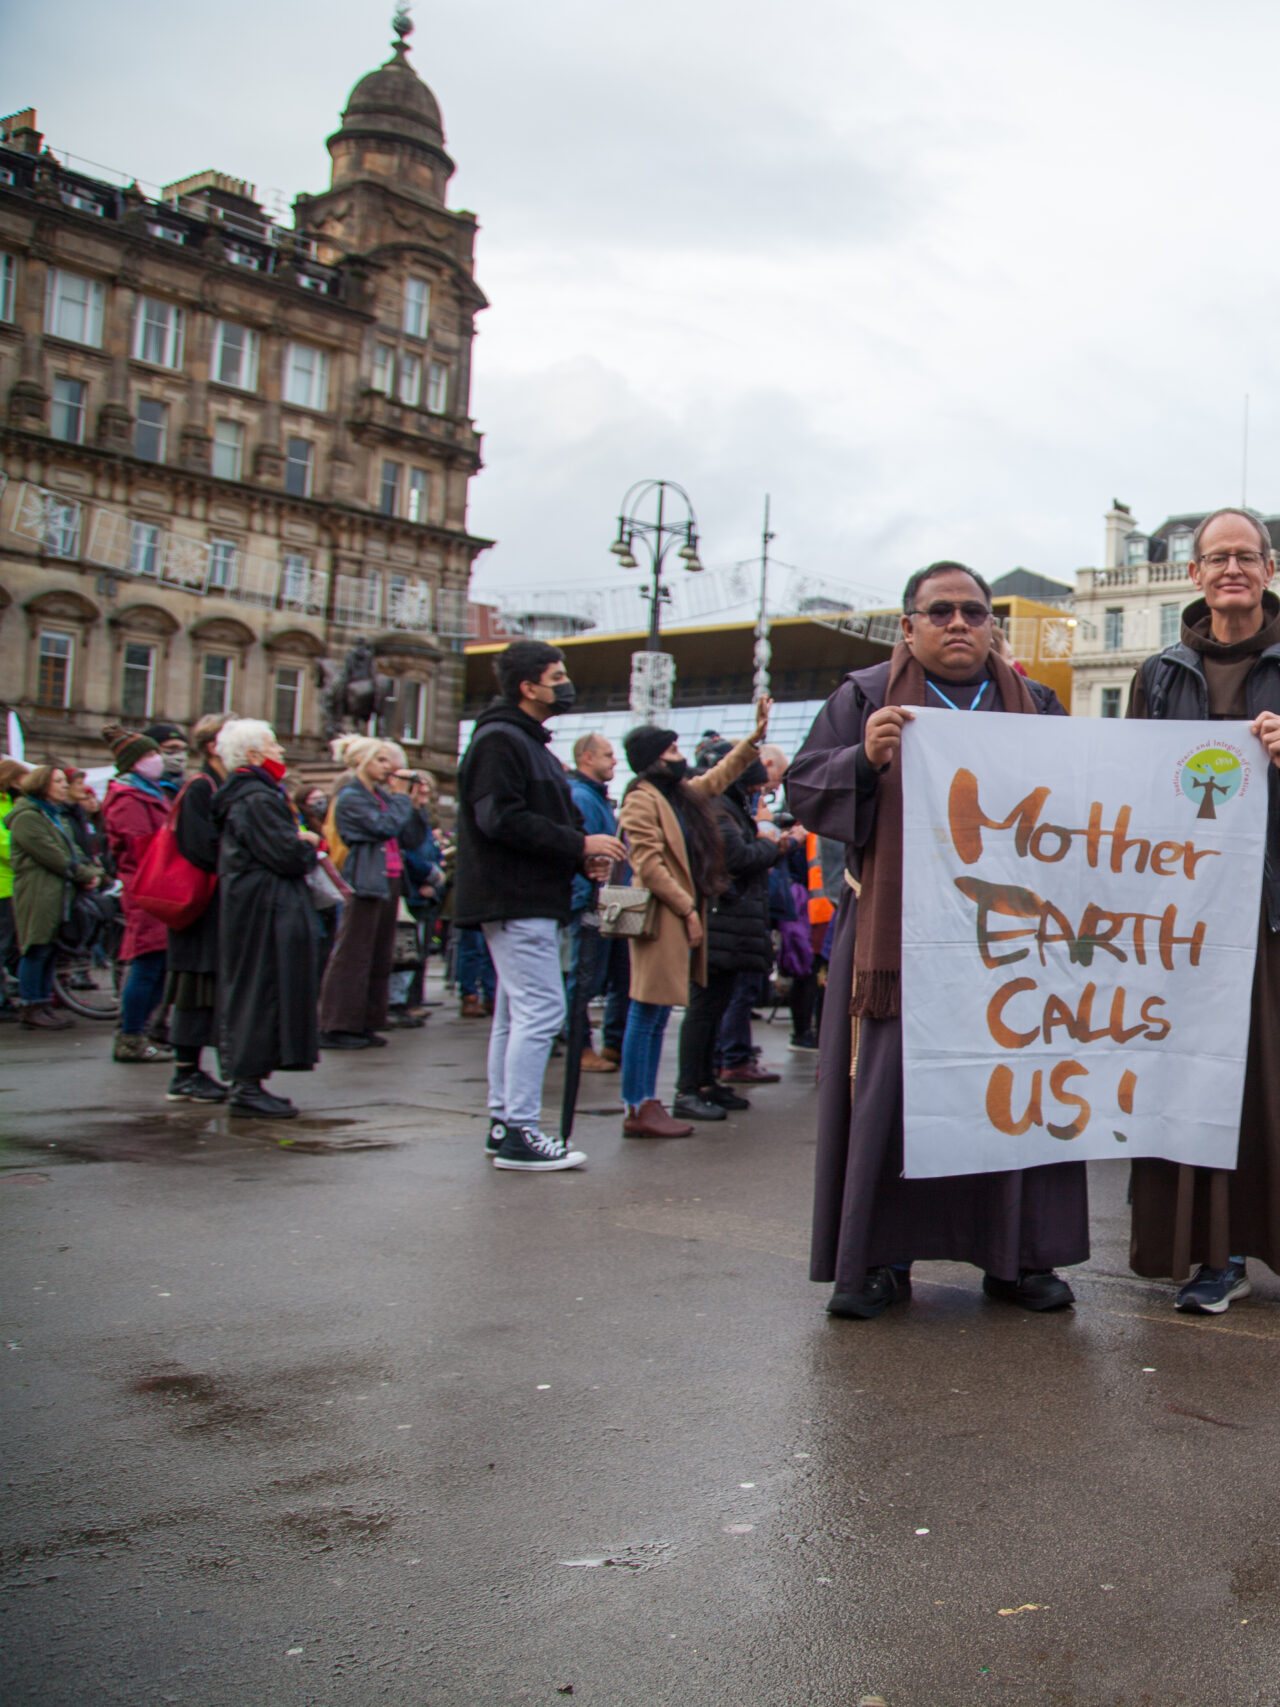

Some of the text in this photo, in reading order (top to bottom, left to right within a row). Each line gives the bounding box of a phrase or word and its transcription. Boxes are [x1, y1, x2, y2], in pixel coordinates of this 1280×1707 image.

[1196, 740, 1211, 750] and
[1177, 750, 1194, 767] Peace
[1240, 758, 1251, 767] of
[1173, 769, 1184, 797] Justice,
[948, 768, 1221, 880] Mother
[954, 877, 1207, 971] EARTH
